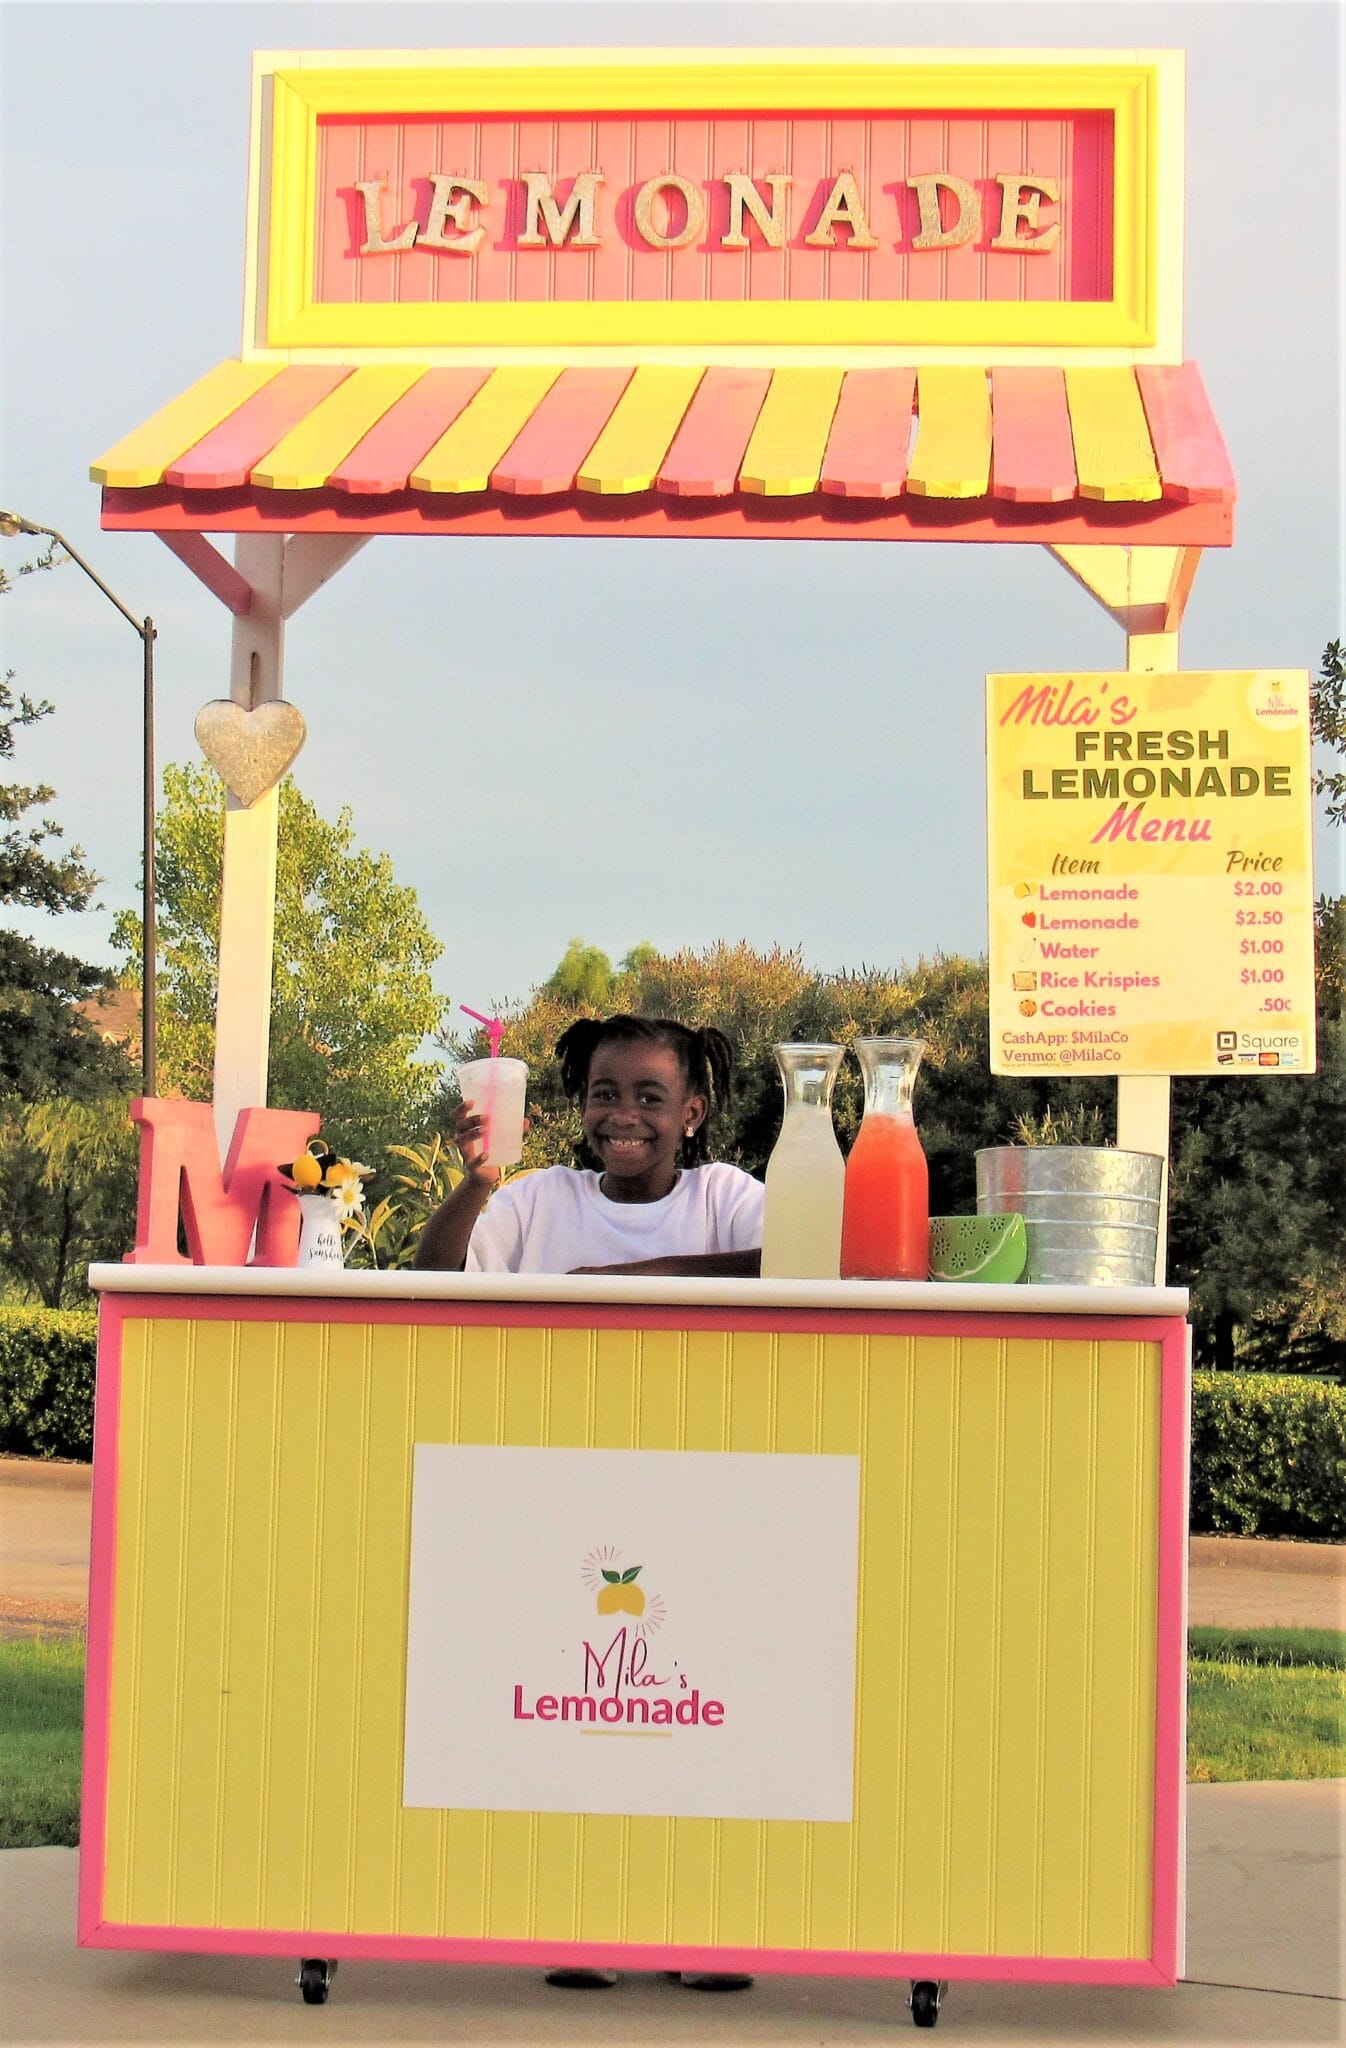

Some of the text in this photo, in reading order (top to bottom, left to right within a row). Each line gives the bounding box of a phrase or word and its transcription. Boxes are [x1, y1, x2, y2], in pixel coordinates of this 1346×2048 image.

[354, 168, 1064, 257] LEMONADE
[1000, 680, 1138, 726] Mila's
[1255, 707, 1298, 716] Lemonade
[1075, 729, 1229, 762] FRESH
[1022, 766, 1292, 800] LEMONADE
[1089, 801, 1212, 844] Menu
[1051, 853, 1100, 876] Item
[1226, 850, 1283, 874] Price
[1039, 883, 1139, 902] Lemonade
[1233, 881, 1283, 897] $2.00
[1040, 912, 1139, 931] Lemonade
[1235, 910, 1284, 927] $2.50
[1040, 942, 1100, 960] Water
[1239, 939, 1284, 956] $1.00
[1040, 971, 1160, 993] Rice Krispies
[1239, 969, 1285, 985] $1.00
[1040, 1000, 1117, 1018] Cookies
[1002, 1030, 1129, 1046] CashApp: $MilaCo
[1241, 1033, 1299, 1051] Square
[1003, 1048, 1122, 1063] Venmo: @MilaCo
[582, 1625, 688, 1698] Mila's
[513, 1684, 725, 1726] Lemonade
